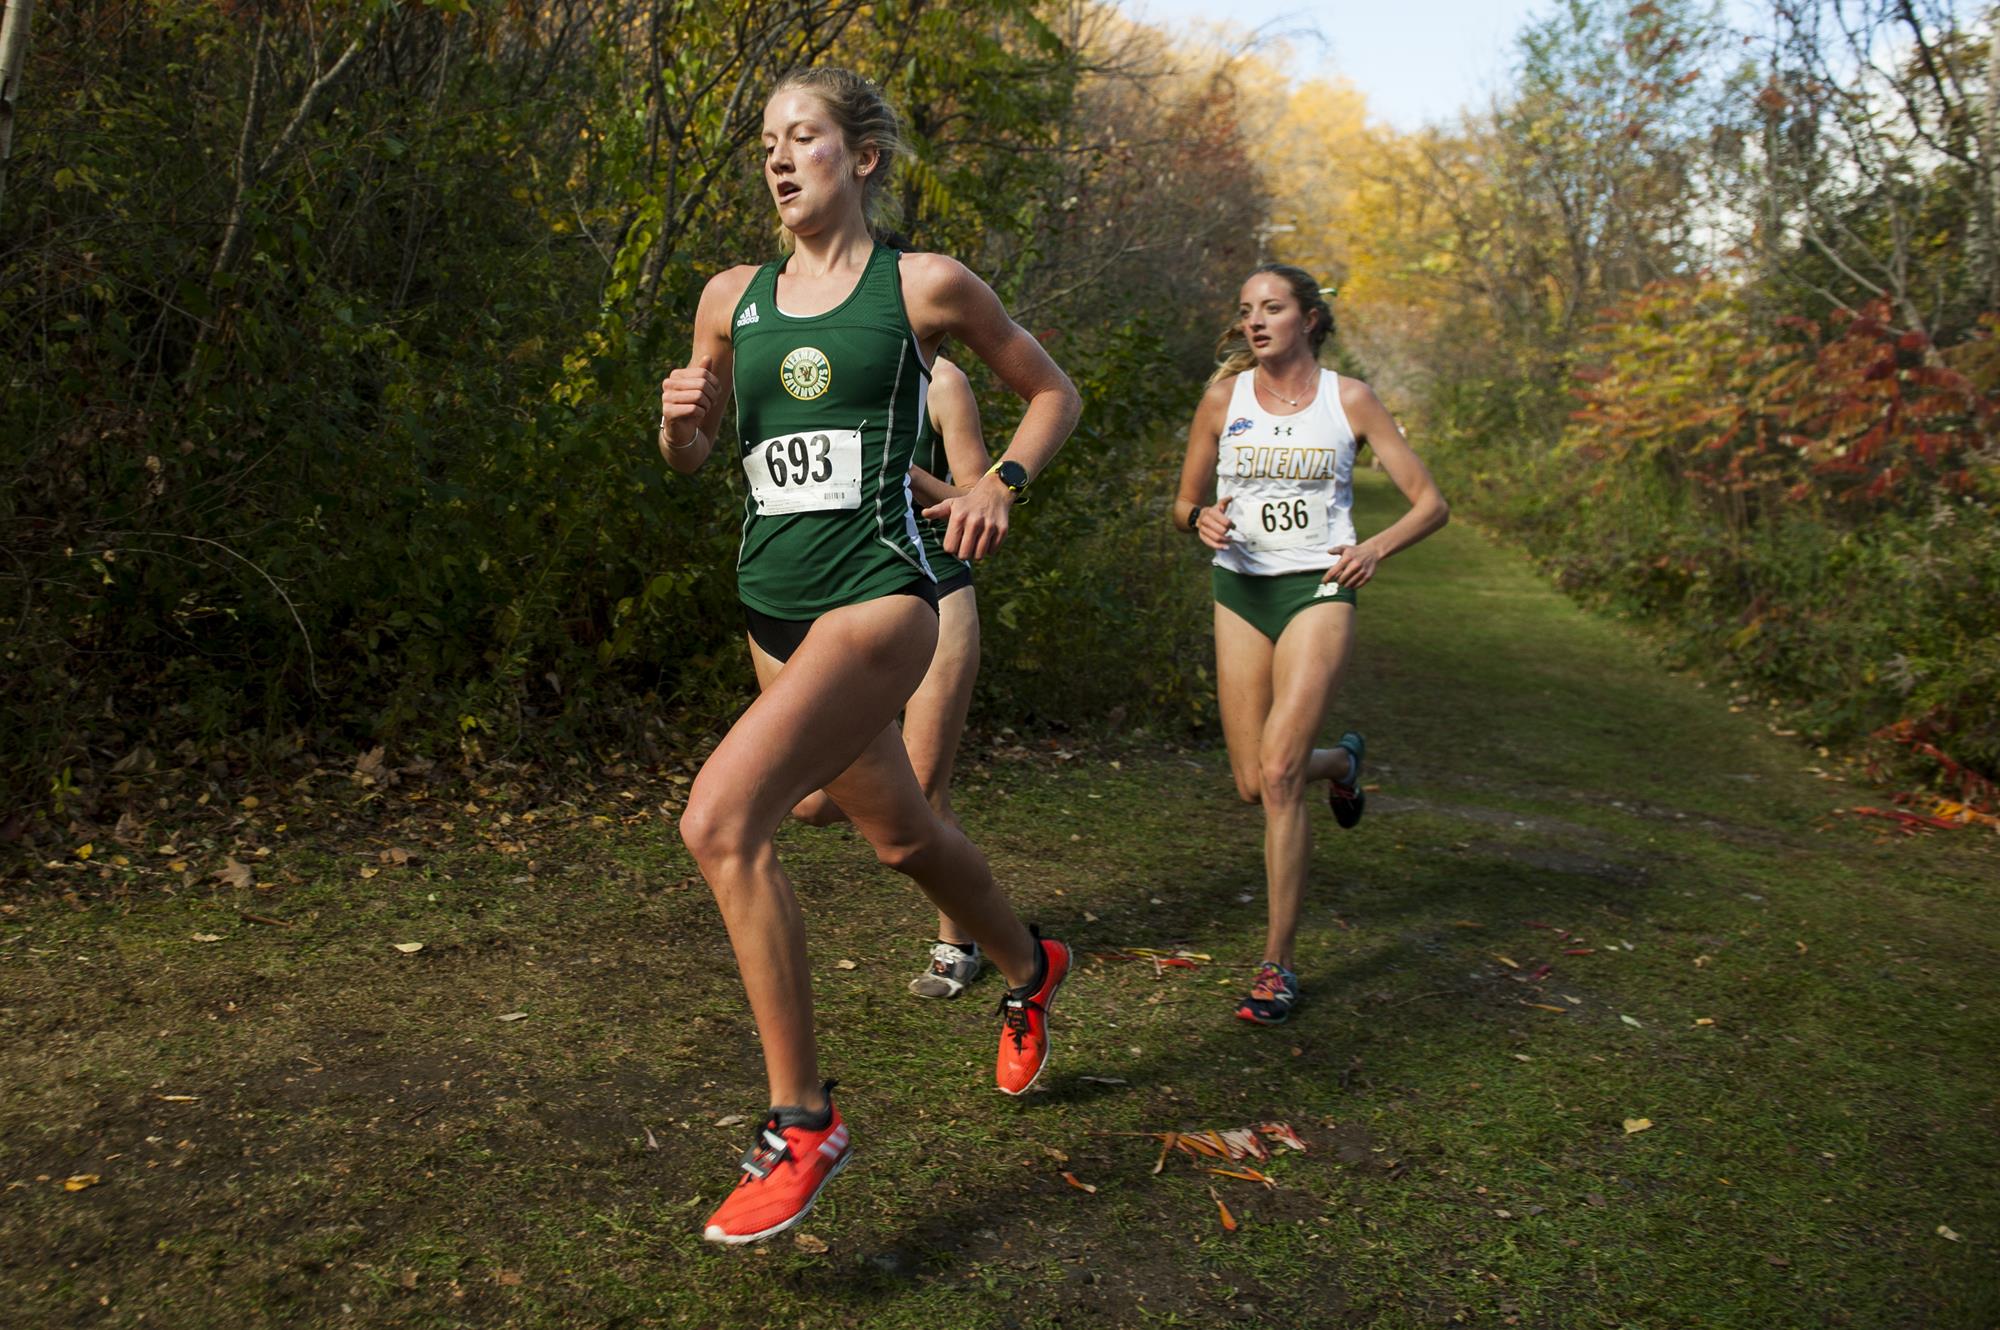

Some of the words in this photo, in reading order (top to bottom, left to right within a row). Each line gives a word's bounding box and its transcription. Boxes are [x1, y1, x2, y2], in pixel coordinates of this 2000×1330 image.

[784, 350, 827, 369] VERMONT
[783, 368, 829, 398] CATAMOUNTS
[765, 433, 833, 488] 693
[1233, 446, 1336, 480] SIENA
[1261, 498, 1309, 533] 636
